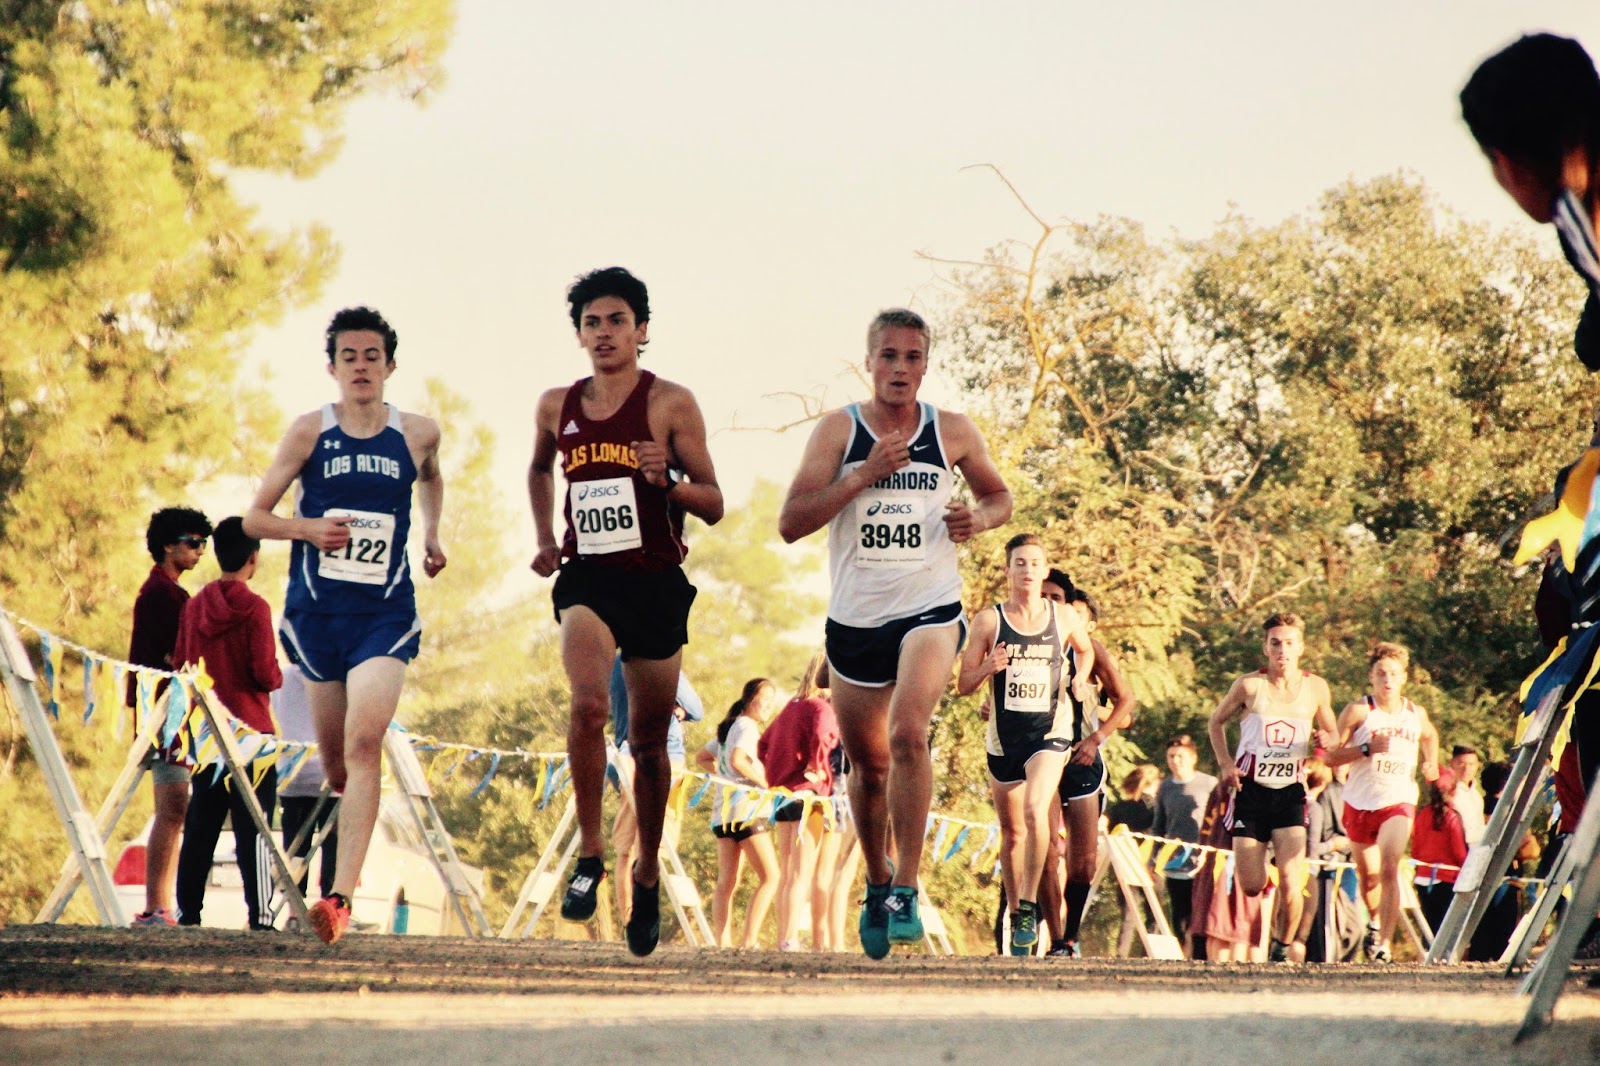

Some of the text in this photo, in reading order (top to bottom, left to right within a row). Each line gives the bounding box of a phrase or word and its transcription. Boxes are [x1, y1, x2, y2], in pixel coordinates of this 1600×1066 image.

[323, 454, 400, 480] LOS ALTOS
[591, 442, 639, 470] LOMAS
[576, 504, 634, 534] 2066
[860, 523, 921, 549] 3948
[1008, 682, 1047, 699] 3697
[1273, 729, 1286, 744] L
[1257, 762, 1294, 778] 2729
